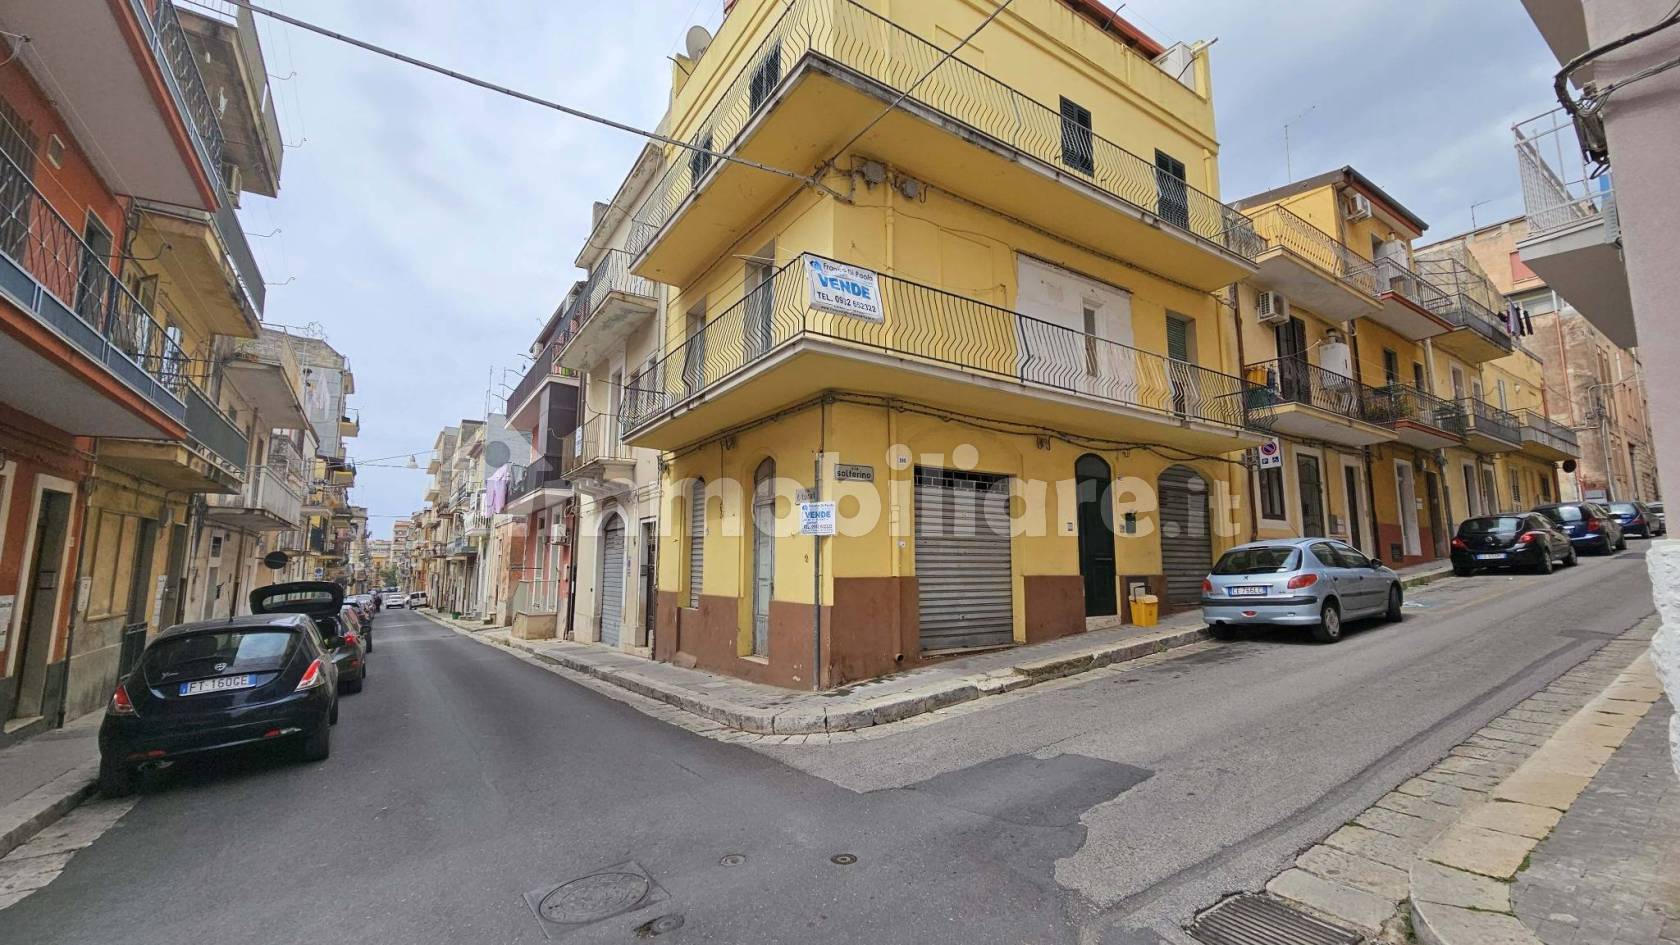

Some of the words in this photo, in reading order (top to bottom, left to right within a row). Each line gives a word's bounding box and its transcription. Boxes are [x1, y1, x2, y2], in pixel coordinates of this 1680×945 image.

[817, 273, 871, 300] VENDE
[817, 291, 833, 302] TEL.
[836, 469, 872, 479] solferino
[805, 511, 832, 519] VENDE
